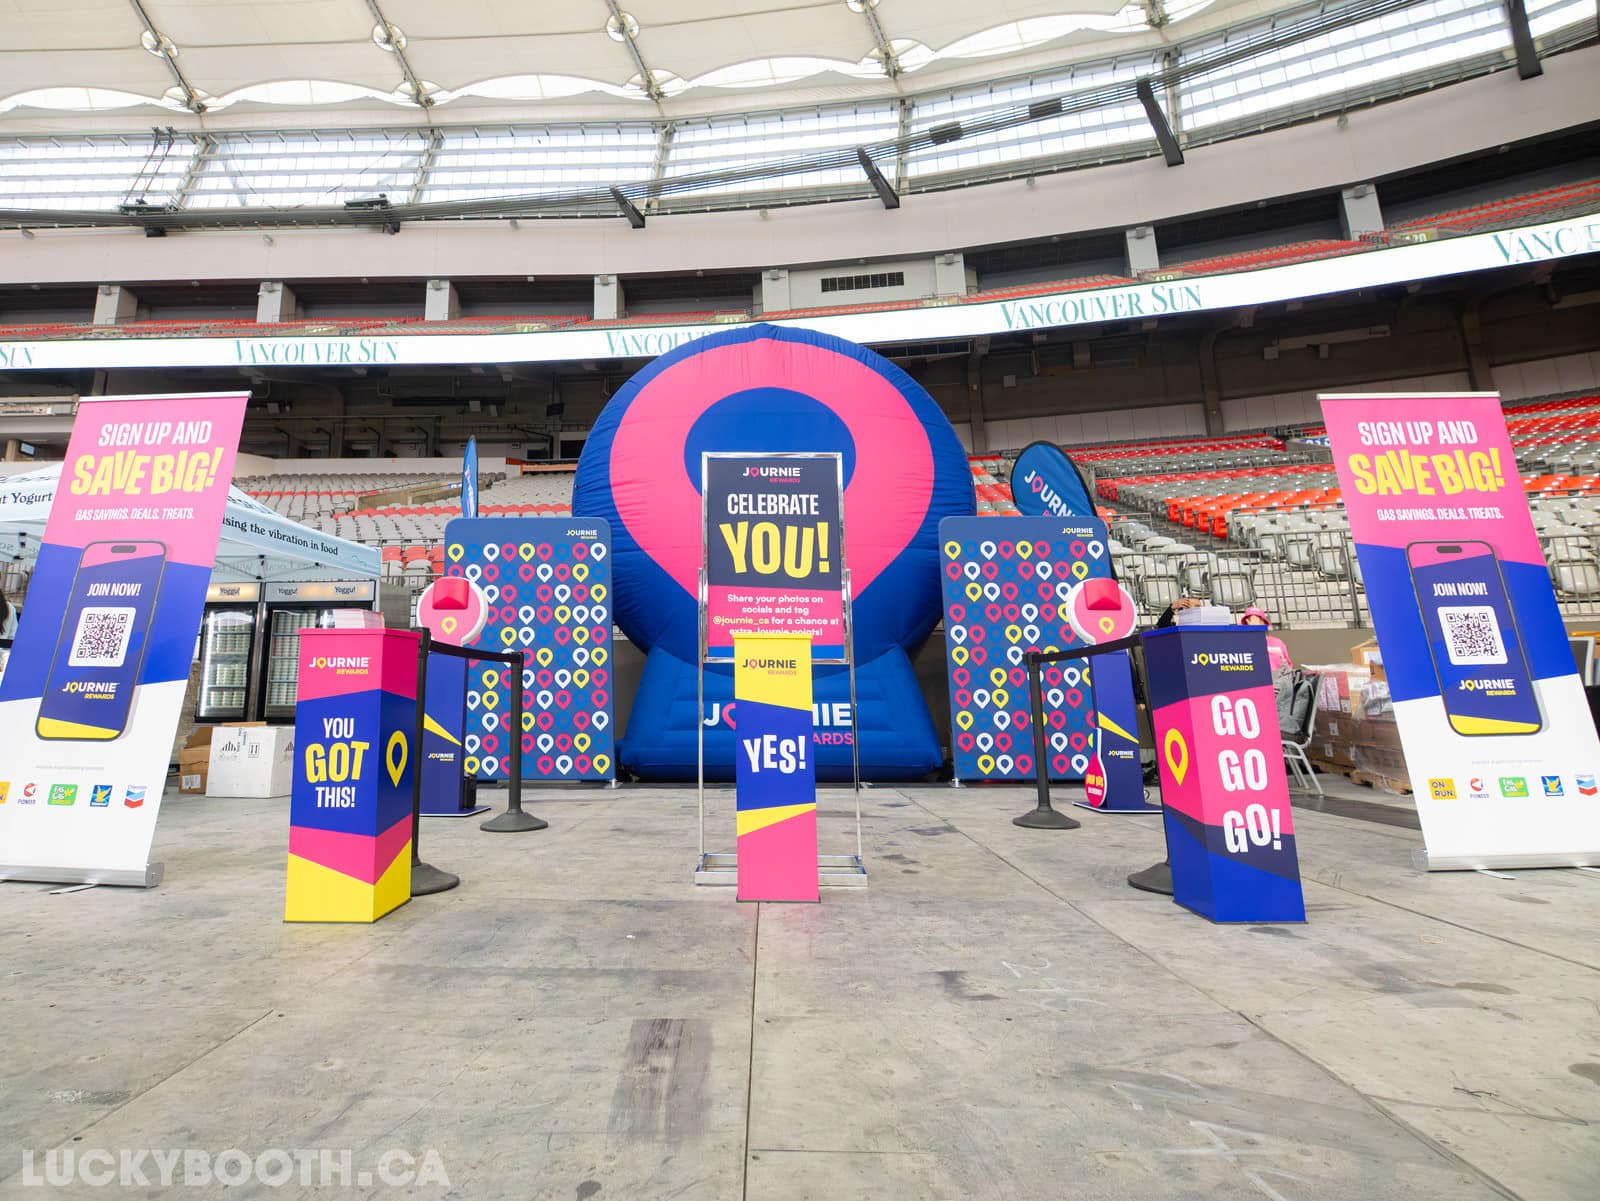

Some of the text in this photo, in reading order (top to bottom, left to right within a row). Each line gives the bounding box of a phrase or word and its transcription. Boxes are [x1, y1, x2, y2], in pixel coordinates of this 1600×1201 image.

[1000, 284, 1202, 329] VANCOUVER SUN
[235, 338, 399, 364] VANCOUVER SUN
[98, 421, 212, 446] SIGN UP AND
[1357, 420, 1478, 446] SIGN UP AND
[70, 447, 224, 496] SAVE BIG!
[743, 467, 801, 477] JOURNIE
[1348, 447, 1505, 495] SAVE BIG!
[12, 492, 53, 505] Yogurt
[727, 493, 819, 515] CELEBRATE
[1024, 470, 1076, 517] JOURN
[75, 508, 195, 521] GAS SAVINGS. DEALS. TREATS.
[1377, 507, 1504, 521] GAS SAVINGS. DEALS. TREATS.
[250, 523, 266, 535] the
[268, 529, 308, 548] vibration
[311, 540, 319, 550] in
[321, 542, 338, 555] food
[719, 521, 830, 579] YOU!
[87, 583, 141, 597] JOIN NOW!
[727, 594, 754, 603] Share
[755, 596, 776, 604] your
[778, 595, 810, 605] photos
[1433, 583, 1488, 596] JOIN NOW!
[712, 615, 770, 627] @journie_ca
[771, 616, 784, 625] for
[794, 617, 828, 625] chance
[830, 617, 839, 625] at
[742, 606, 809, 616] socials and tag
[309, 657, 369, 669] JOURNIE
[742, 659, 797, 669] JOURNIE
[1191, 653, 1253, 666] JOURNIE
[62, 681, 119, 693] JOURNIE
[1459, 679, 1515, 691] JOURNIE
[1210, 695, 1261, 739] GO
[323, 718, 354, 739] YOU
[305, 740, 370, 784] GOT
[742, 734, 807, 774] YES!
[1217, 749, 1268, 792] GO
[315, 787, 356, 808] THIS!
[1222, 803, 1282, 854] GO!
